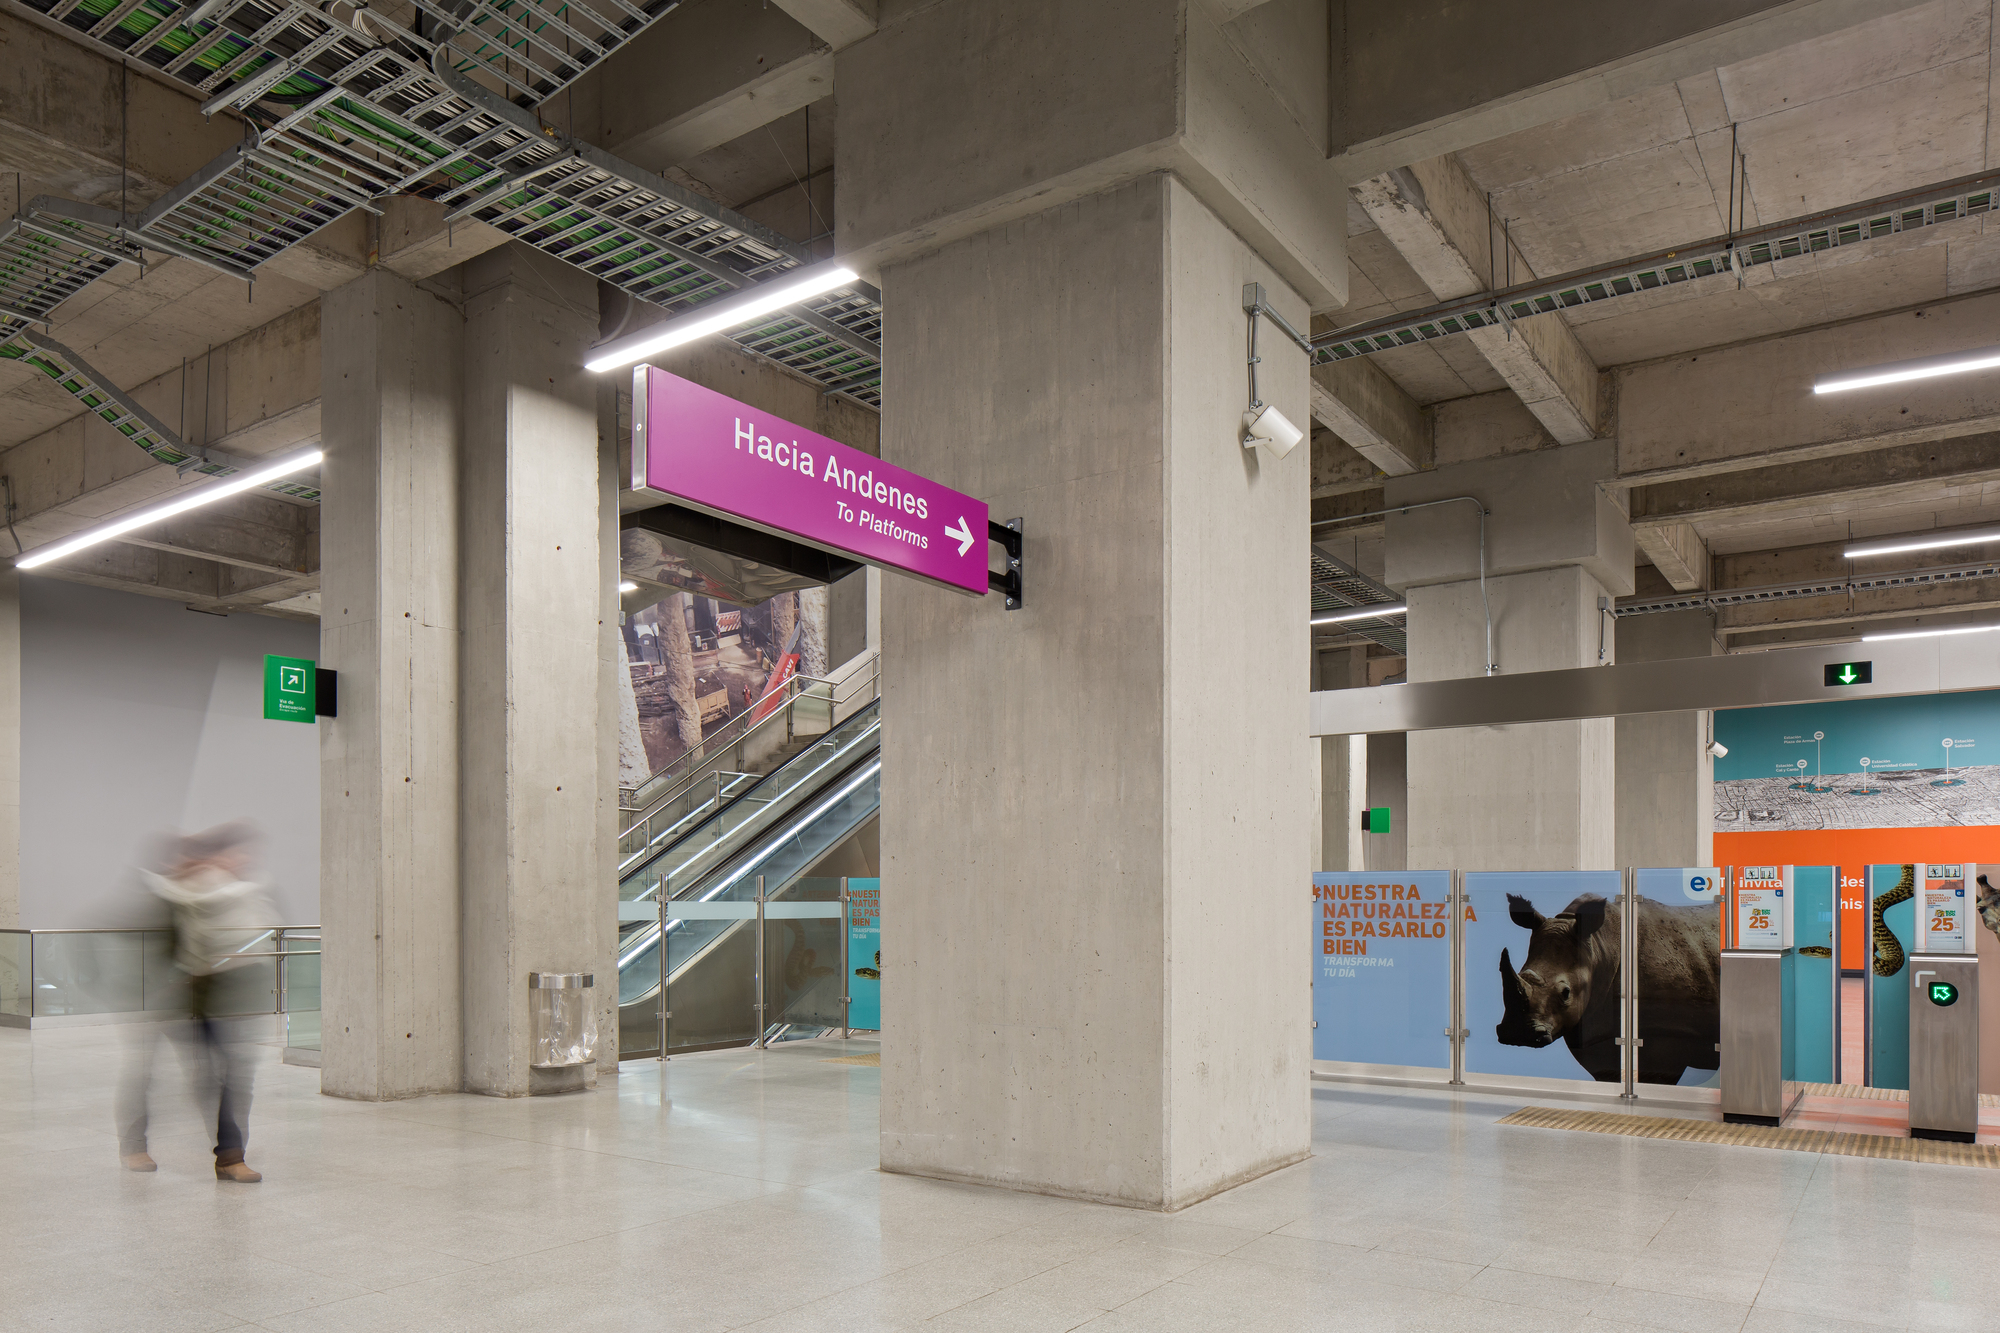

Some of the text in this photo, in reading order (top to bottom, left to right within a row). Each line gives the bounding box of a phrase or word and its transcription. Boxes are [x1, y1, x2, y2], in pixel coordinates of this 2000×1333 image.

[734, 417, 928, 519] Hacia Andenes
[836, 501, 929, 549] To Platforms
[852, 889, 880, 898] NUEST
[1323, 884, 1421, 901] NUESTRA
[852, 908, 862, 917] ES
[852, 918, 871, 926] BIEN
[1323, 921, 1446, 939] ES PASARLO
[1323, 938, 1367, 955] BIEN
[1323, 956, 1394, 967] TRANSFORMA
[1323, 966, 1356, 978] TU DÍA
